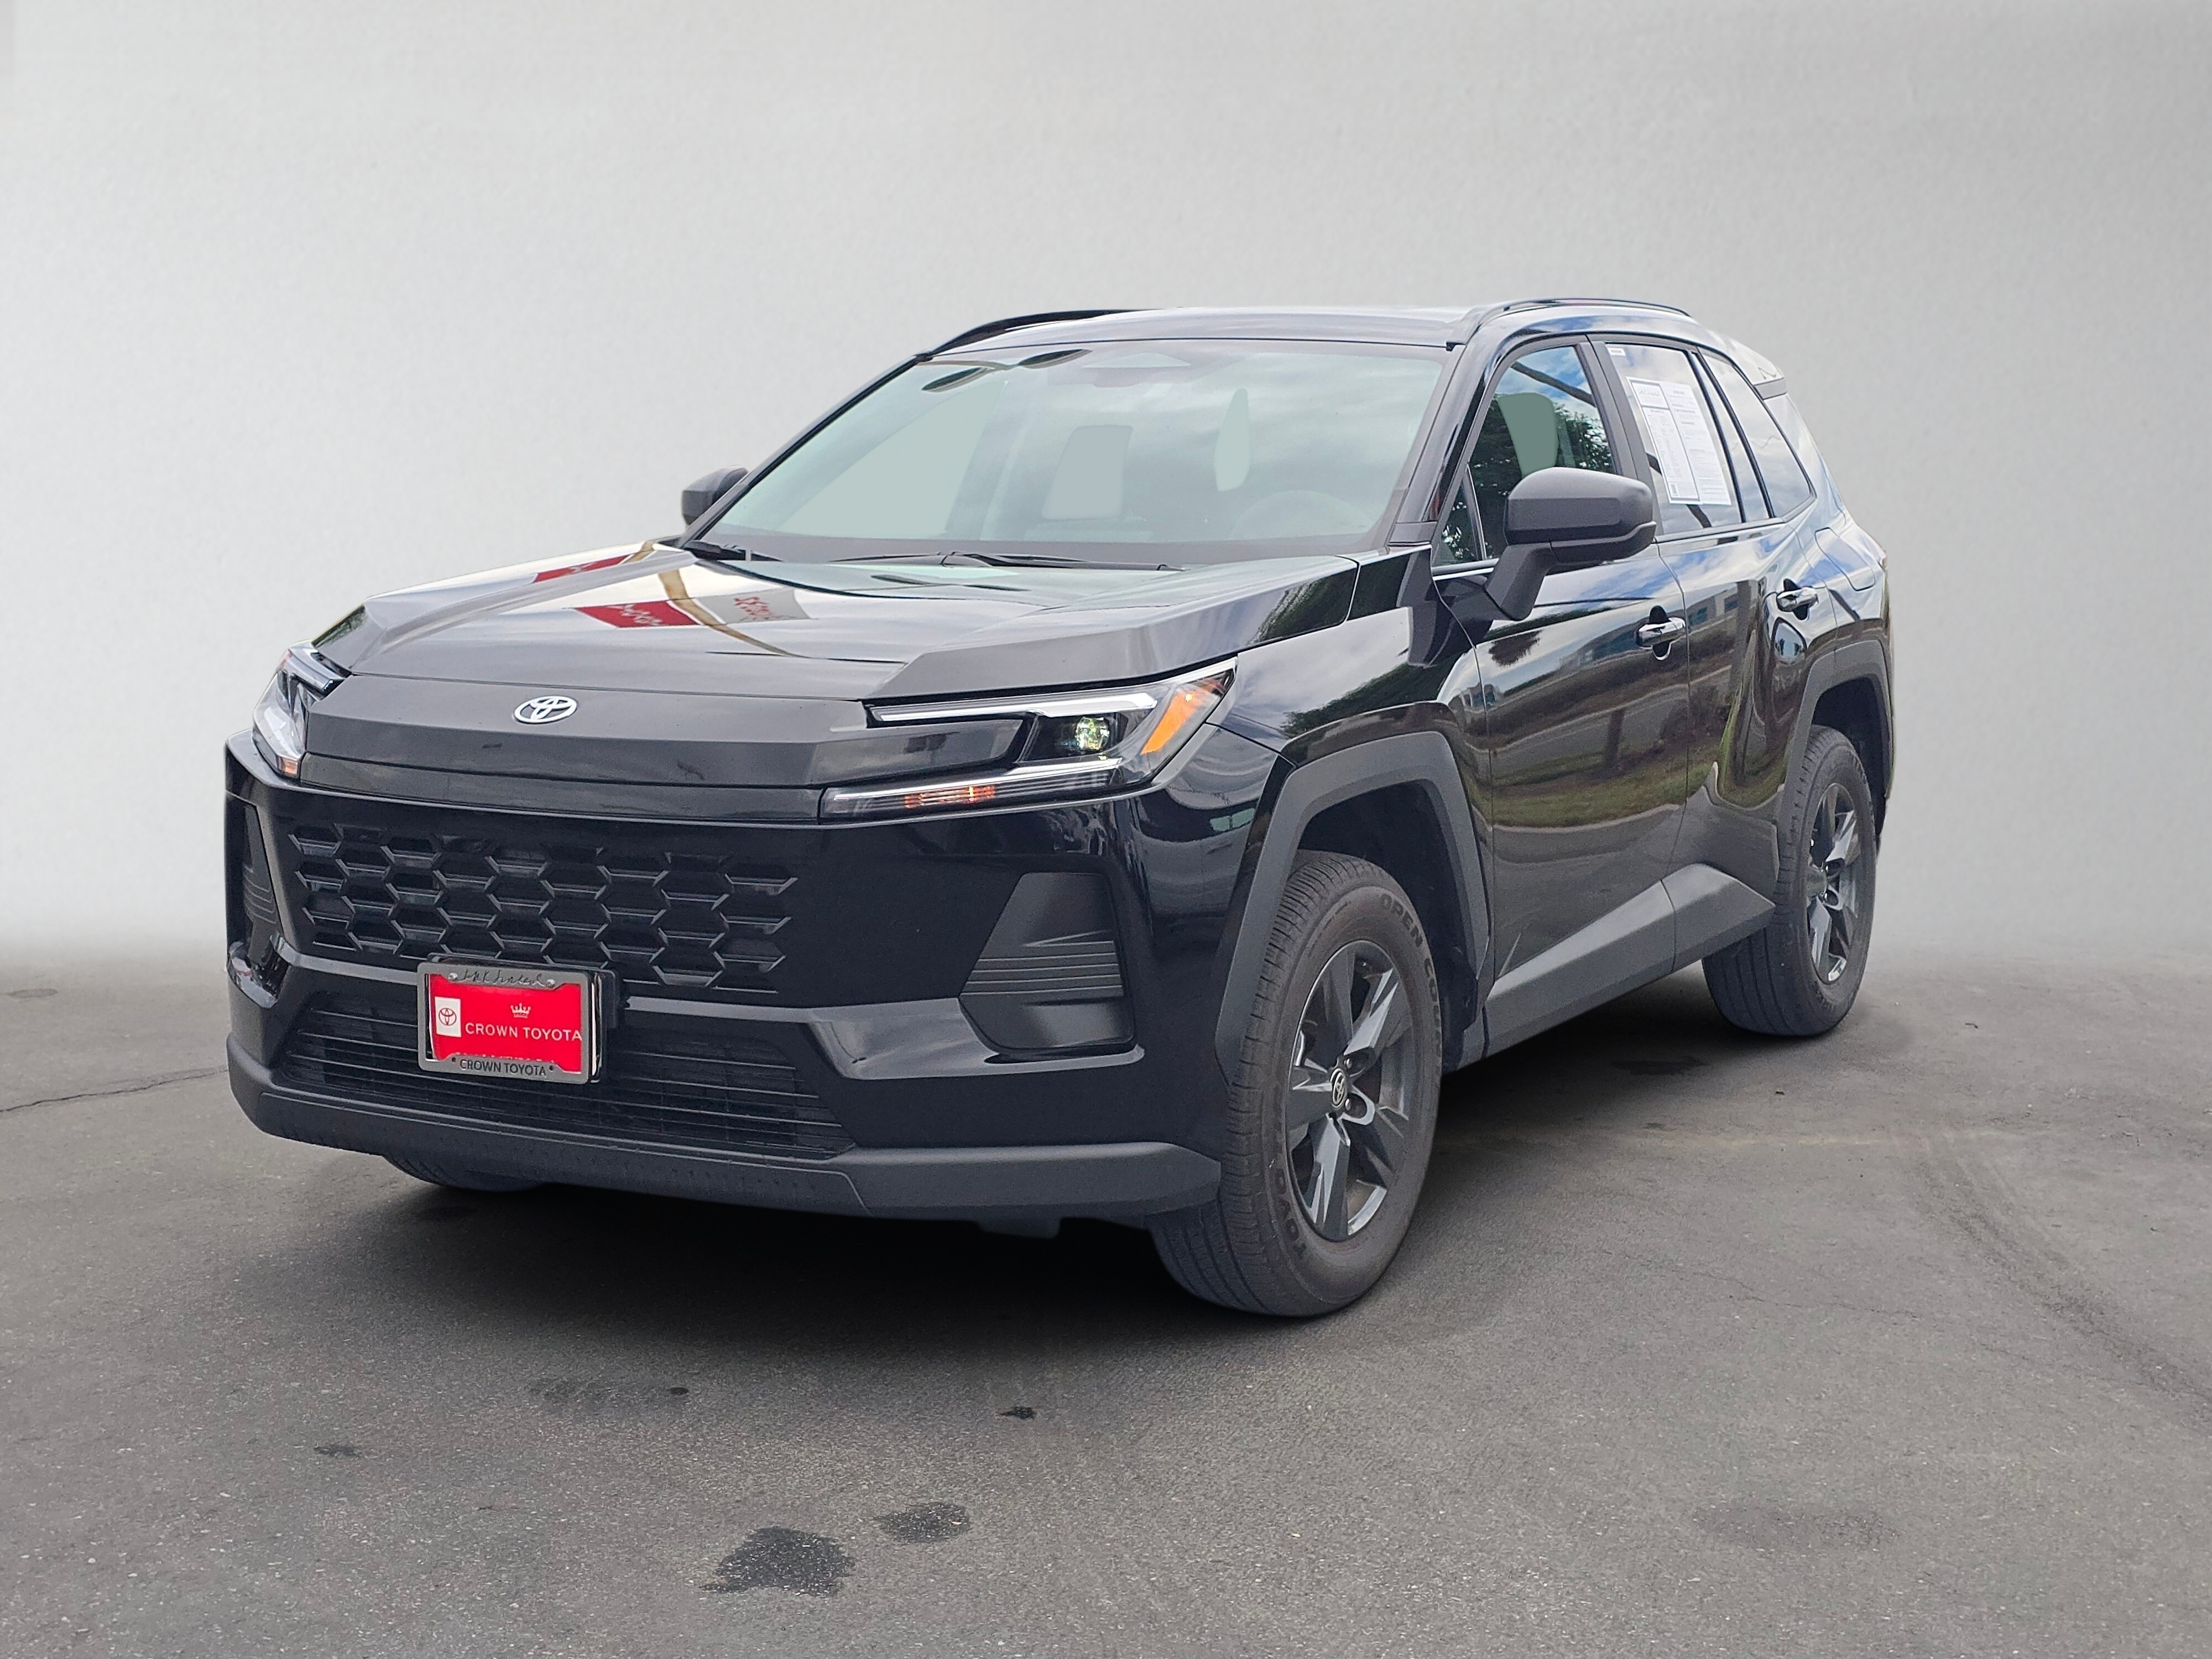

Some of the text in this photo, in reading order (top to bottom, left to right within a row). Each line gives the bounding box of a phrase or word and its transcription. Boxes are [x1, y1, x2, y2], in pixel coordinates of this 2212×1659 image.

[1380, 894, 1423, 948] OPEN
[465, 1022, 582, 1041] CROWN TOYOTA
[460, 1059, 547, 1076] CROWN TOYOTA
